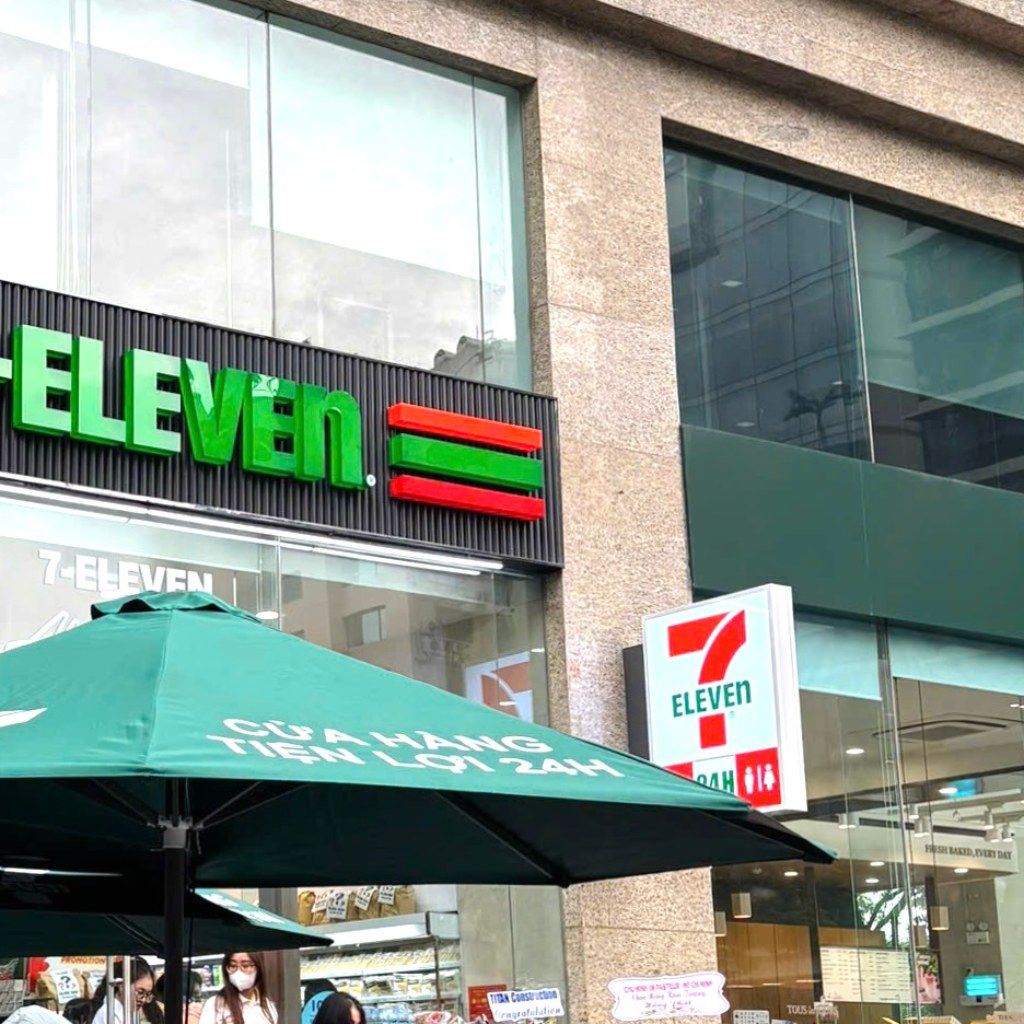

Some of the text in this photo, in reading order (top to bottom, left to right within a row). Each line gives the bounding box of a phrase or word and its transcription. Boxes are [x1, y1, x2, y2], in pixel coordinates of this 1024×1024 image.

[205, 734, 366, 765] TIỆN
[499, 757, 625, 778] 24H
[787, 1004, 807, 1014] TOUS
